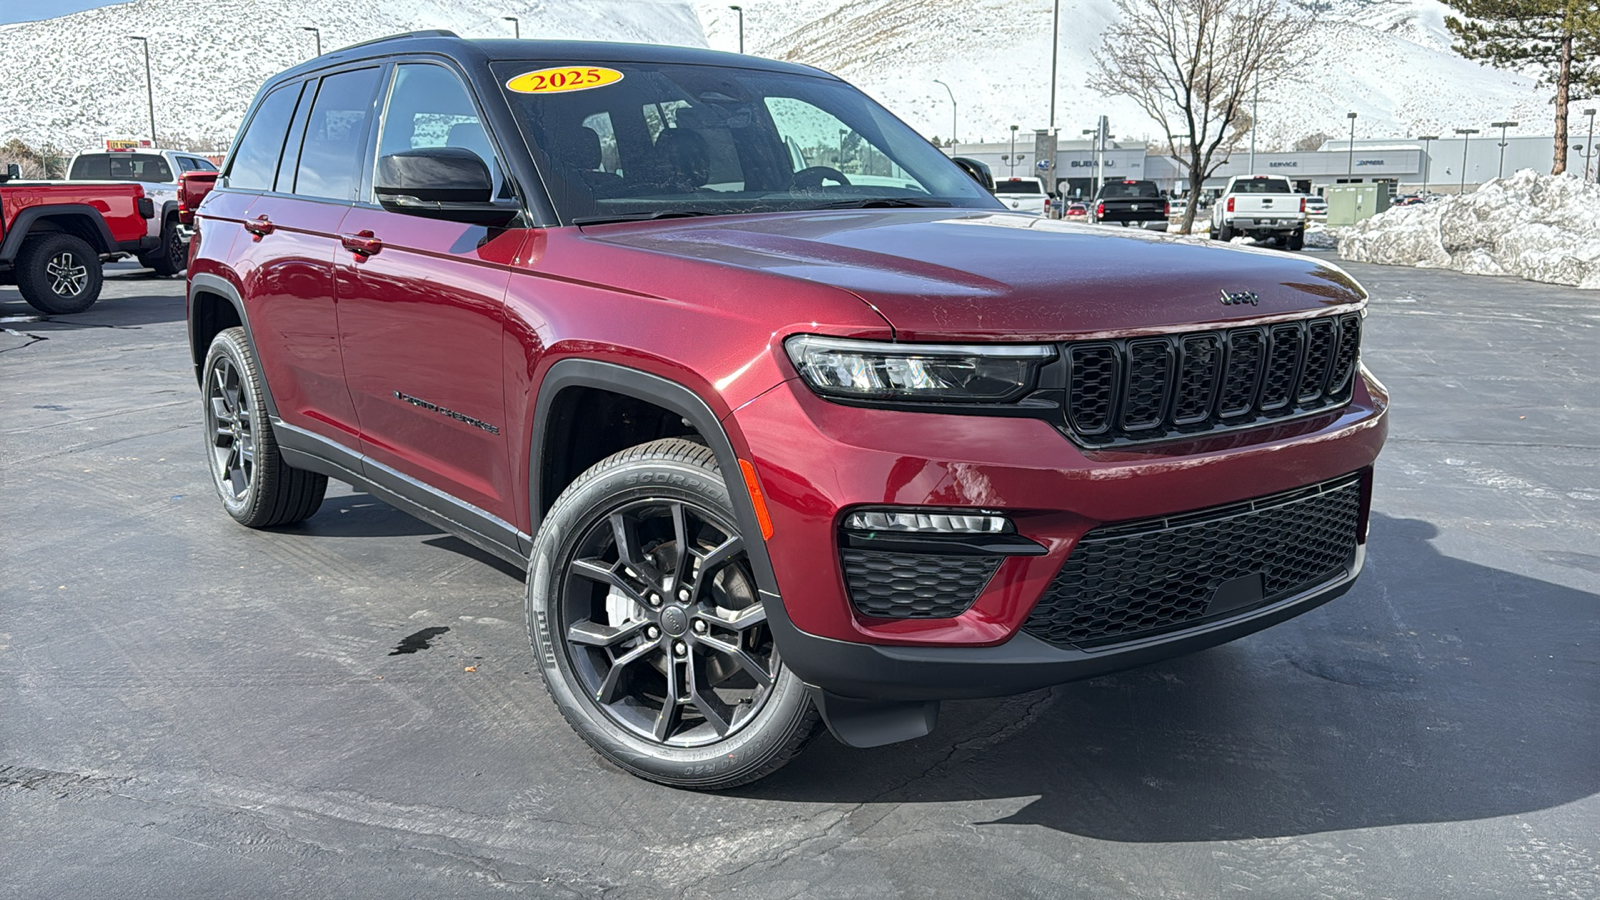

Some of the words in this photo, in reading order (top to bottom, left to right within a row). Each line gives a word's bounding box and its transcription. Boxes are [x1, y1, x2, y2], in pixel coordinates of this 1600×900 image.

[530, 69, 601, 91] 2025
[1220, 289, 1259, 306] Jeep
[534, 611, 556, 669] PIRELLI
